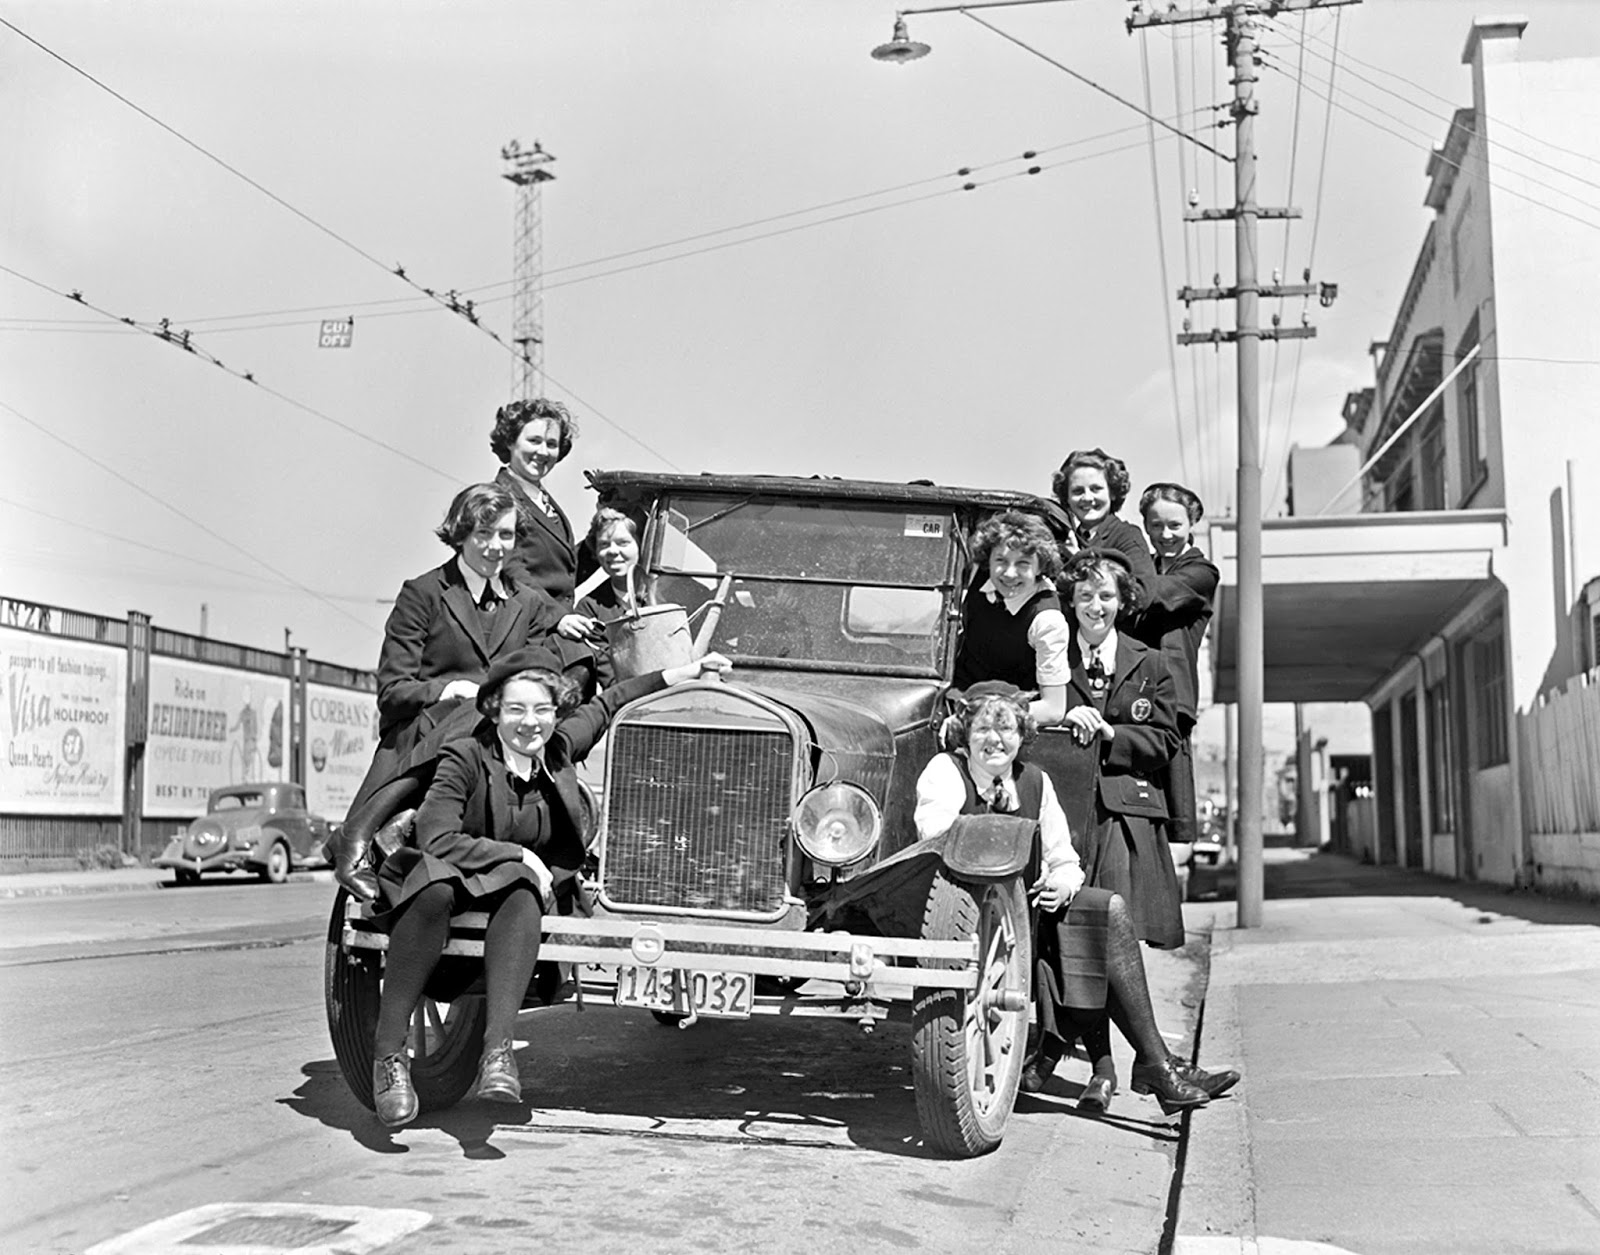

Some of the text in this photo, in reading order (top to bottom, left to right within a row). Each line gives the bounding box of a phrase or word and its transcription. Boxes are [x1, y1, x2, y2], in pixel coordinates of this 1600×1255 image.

[323, 322, 349, 333] CUT
[321, 335, 350, 346] OFF
[923, 523, 940, 534] CAR
[8, 672, 52, 738] Visa
[53, 707, 109, 725] HOLEPROOF
[156, 784, 178, 798] BEST
[182, 786, 193, 799] BY
[625, 966, 747, 1013] 143 032
